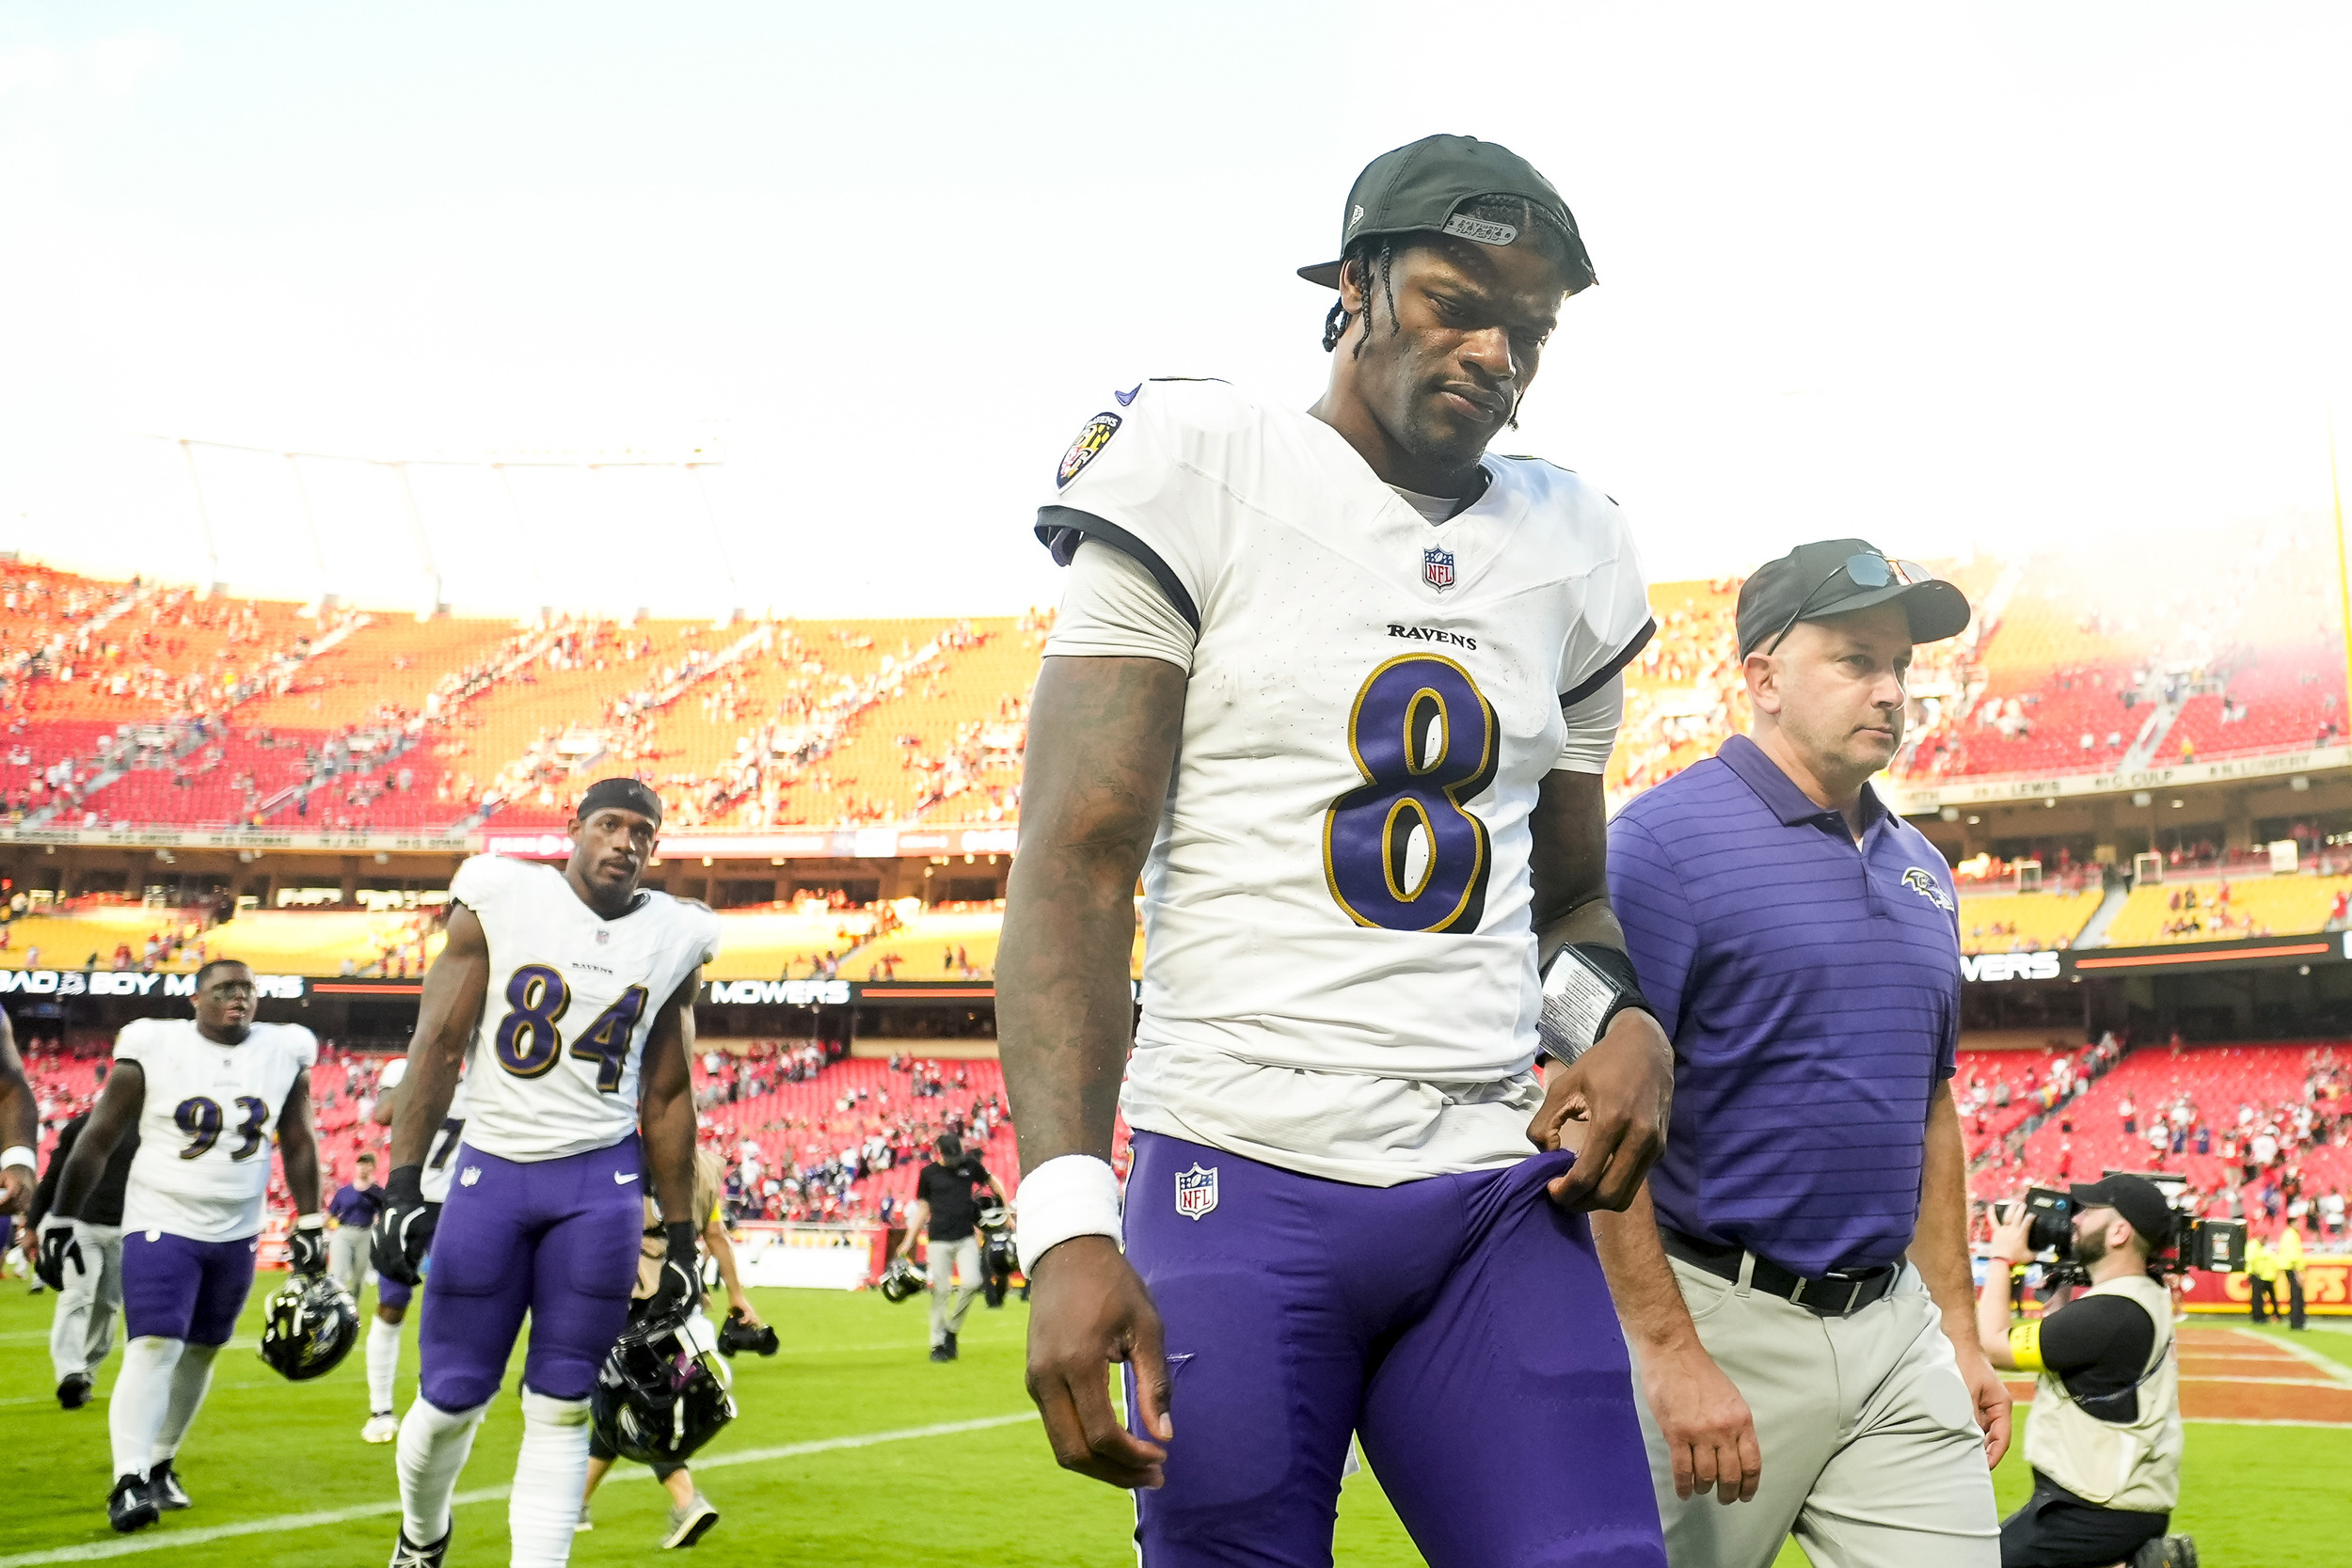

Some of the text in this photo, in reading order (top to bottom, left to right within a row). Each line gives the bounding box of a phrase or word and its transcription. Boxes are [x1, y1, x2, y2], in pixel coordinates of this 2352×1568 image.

[1427, 563, 1454, 583] NFL
[1387, 624, 1478, 652] RAVENS
[1322, 652, 1502, 935] 8
[1960, 951, 2060, 982] WERS
[89, 972, 160, 995] BOY
[710, 980, 850, 1004] MOWERS
[496, 964, 649, 1093] 84
[174, 1095, 270, 1163] 93
[1183, 1189, 1210, 1210] NFL
